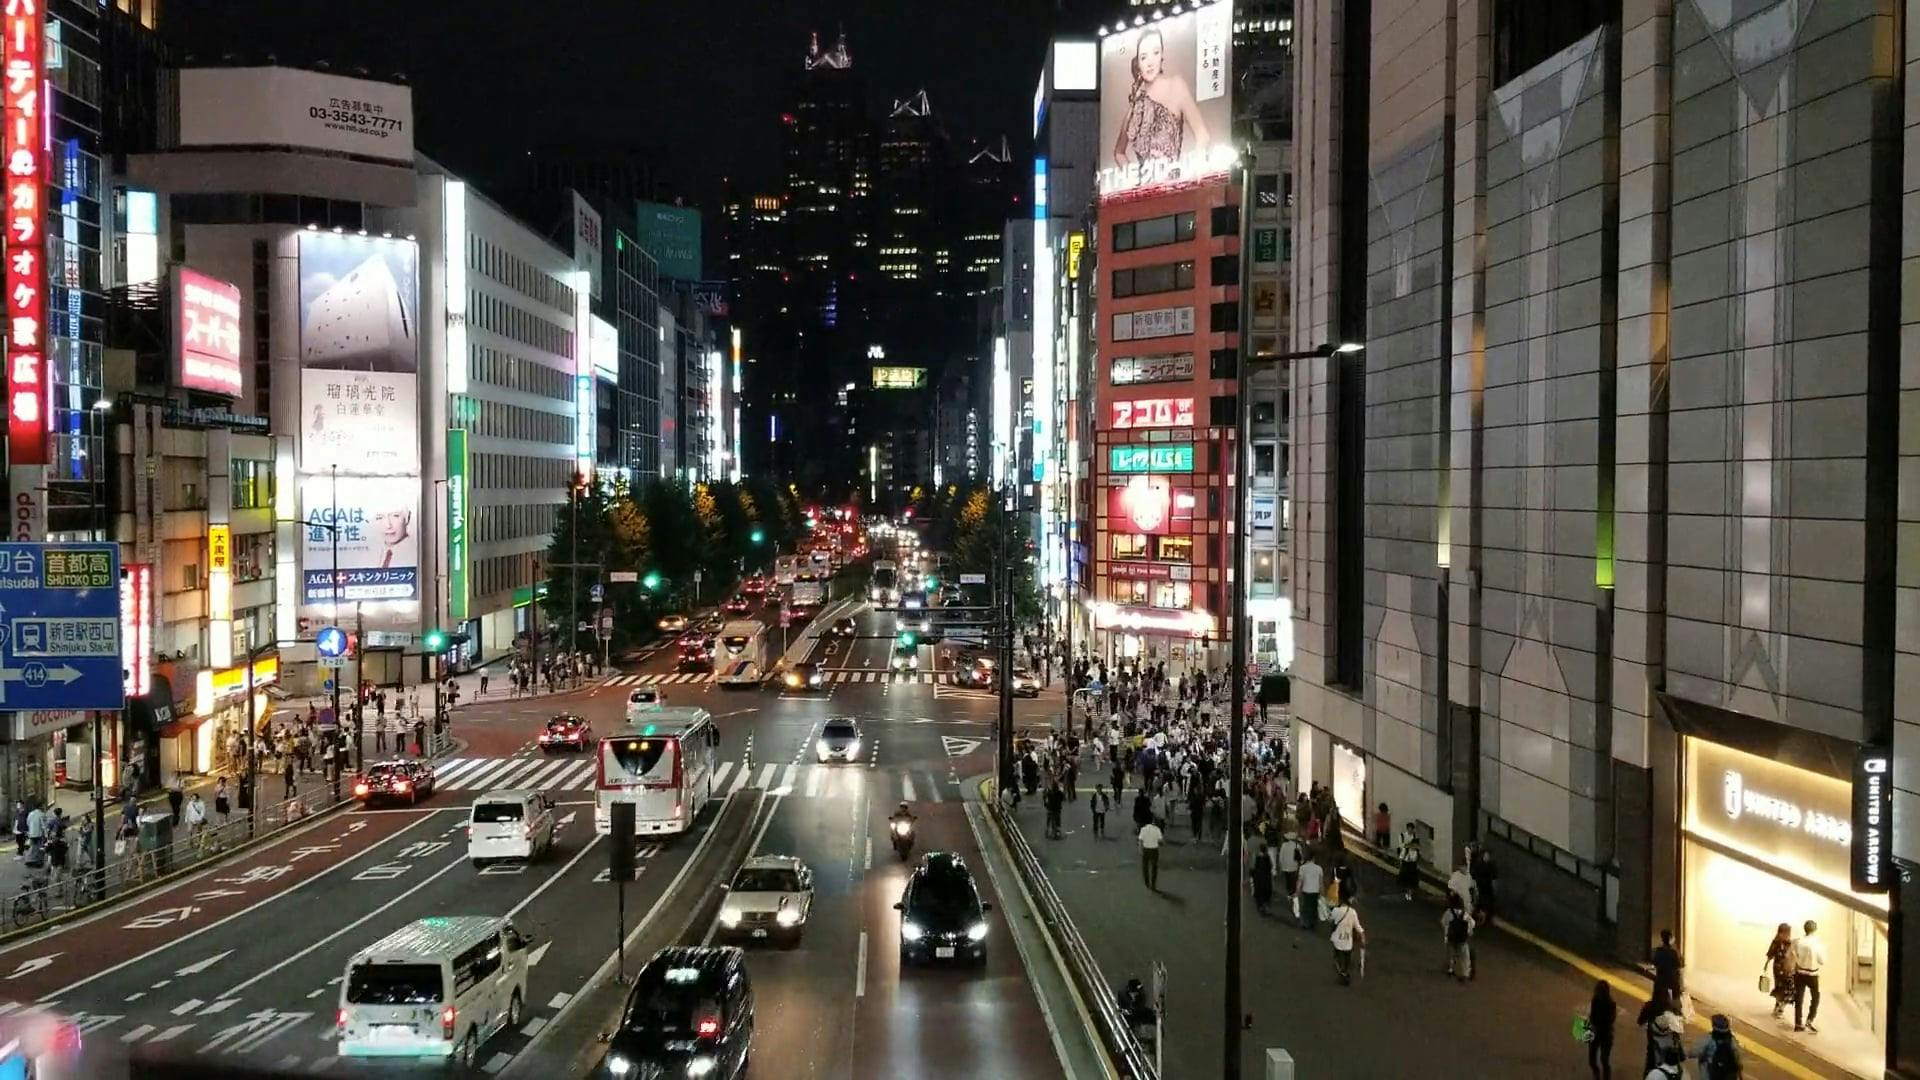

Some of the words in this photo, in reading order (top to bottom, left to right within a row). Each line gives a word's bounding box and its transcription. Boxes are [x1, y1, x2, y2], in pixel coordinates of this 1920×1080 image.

[329, 97, 384, 115] 広告募集中
[309, 106, 403, 131] 03-3543-7771
[327, 383, 396, 401] 瑠璃光院
[1113, 401, 1173, 428] アコム
[214, 534, 225, 567] 大黒屋
[47, 553, 109, 574] 首都高
[47, 574, 90, 586] SHUTOKO
[92, 574, 110, 586] EXP
[308, 573, 334, 585] AGA
[348, 571, 415, 583] スキンクリニック
[50, 622, 114, 642] 新宿駅西口
[50, 642, 87, 655] Shinjuku
[25, 668, 45, 682] 414
[1868, 776, 1880, 825] UNITED
[1867, 829, 1880, 884] ARROWS
